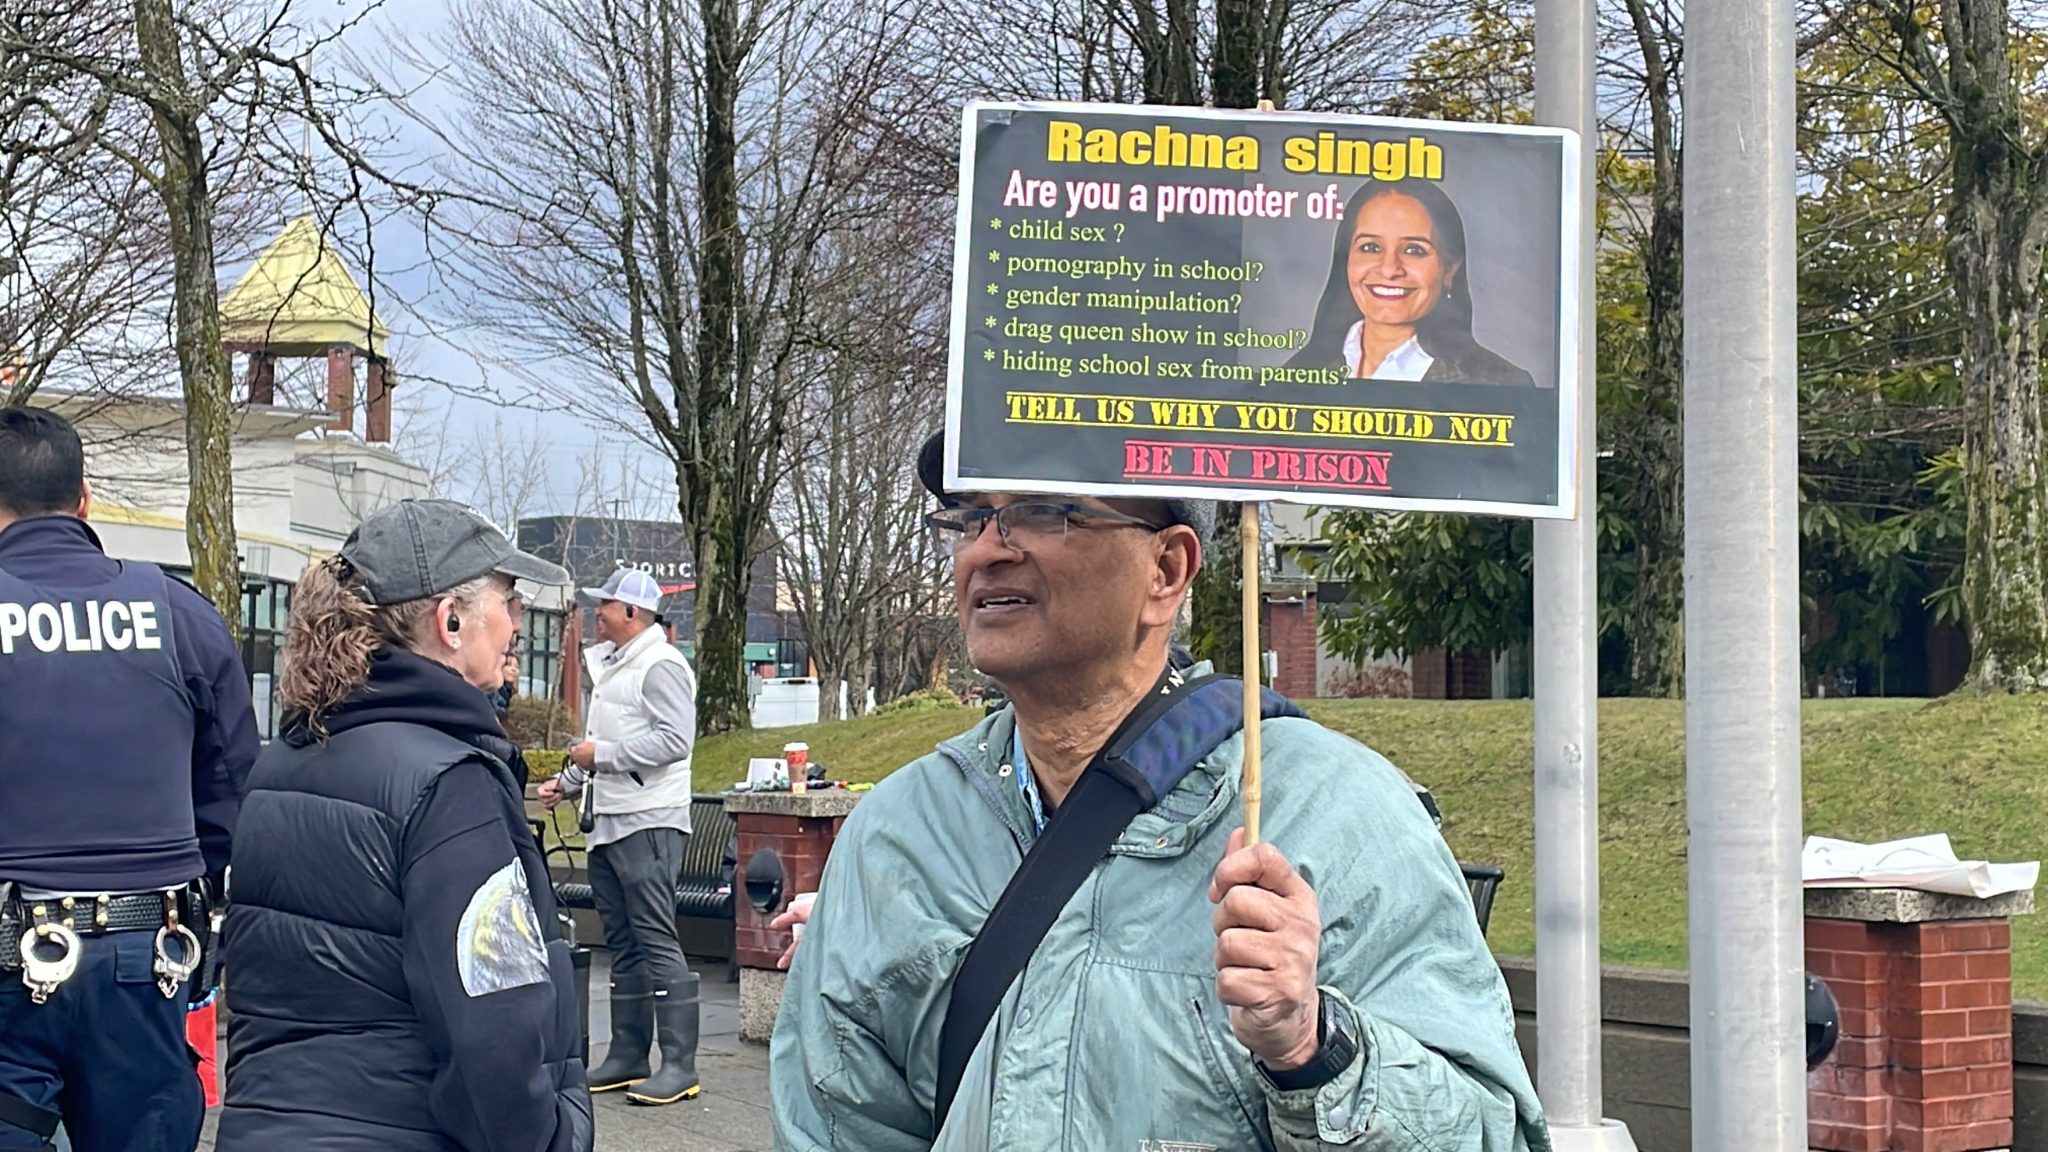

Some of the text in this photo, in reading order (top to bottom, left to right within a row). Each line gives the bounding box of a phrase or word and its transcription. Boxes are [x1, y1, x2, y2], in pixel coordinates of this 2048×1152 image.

[1047, 120, 1443, 182] Rachna singh
[1003, 169, 1344, 223] Are you a promoter of:
[1009, 218, 1126, 243] child sex ?
[1006, 255, 1264, 282] pornography in school?
[1005, 285, 1242, 315] gender manipulation?
[1003, 316, 1307, 350] drag queen show in school?
[1002, 348, 1352, 387] hiding school sex from parents?
[1006, 395, 1513, 442] TELL US WHY YOU SHOULD NOT
[1123, 445, 1391, 485] BE IN PRISON
[0, 599, 162, 654] POLICE
